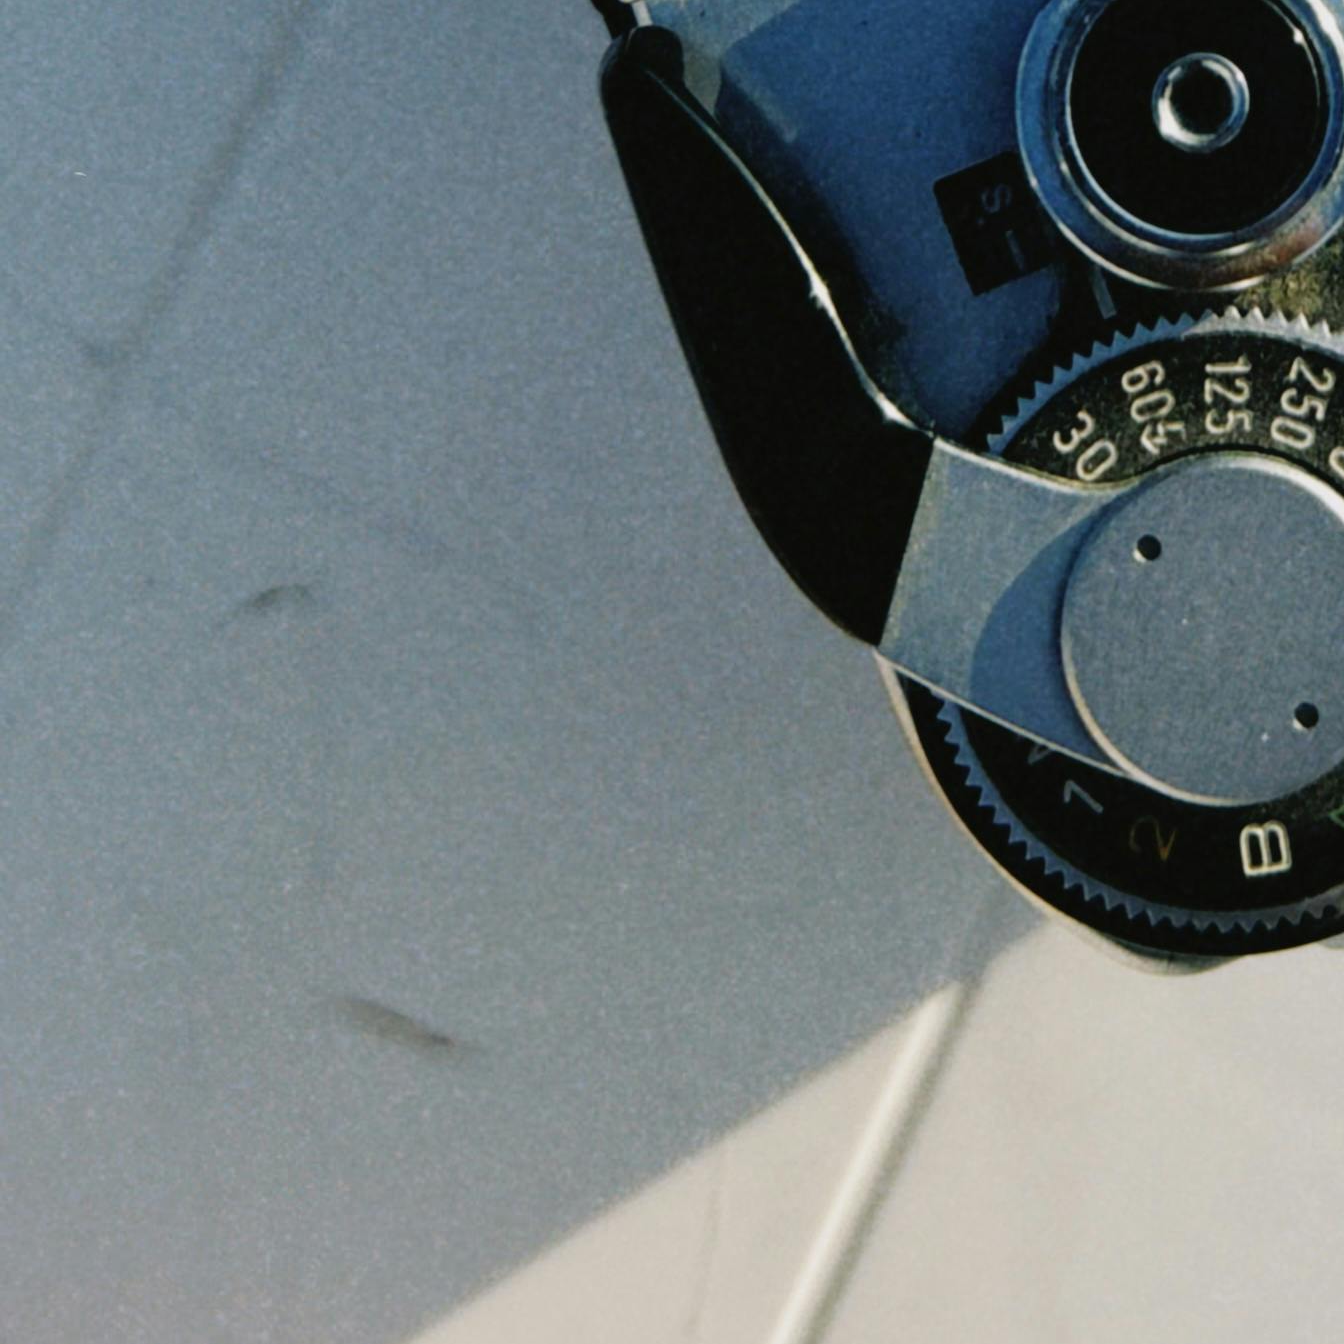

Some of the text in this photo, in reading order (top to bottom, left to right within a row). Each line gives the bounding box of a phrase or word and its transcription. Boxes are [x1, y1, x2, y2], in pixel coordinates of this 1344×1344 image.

[1120, 358, 1178, 423] 60
[1204, 354, 1252, 437] 125
[1269, 354, 1337, 453] 250
[1051, 408, 1120, 483] 30
[1238, 820, 1294, 878] B
